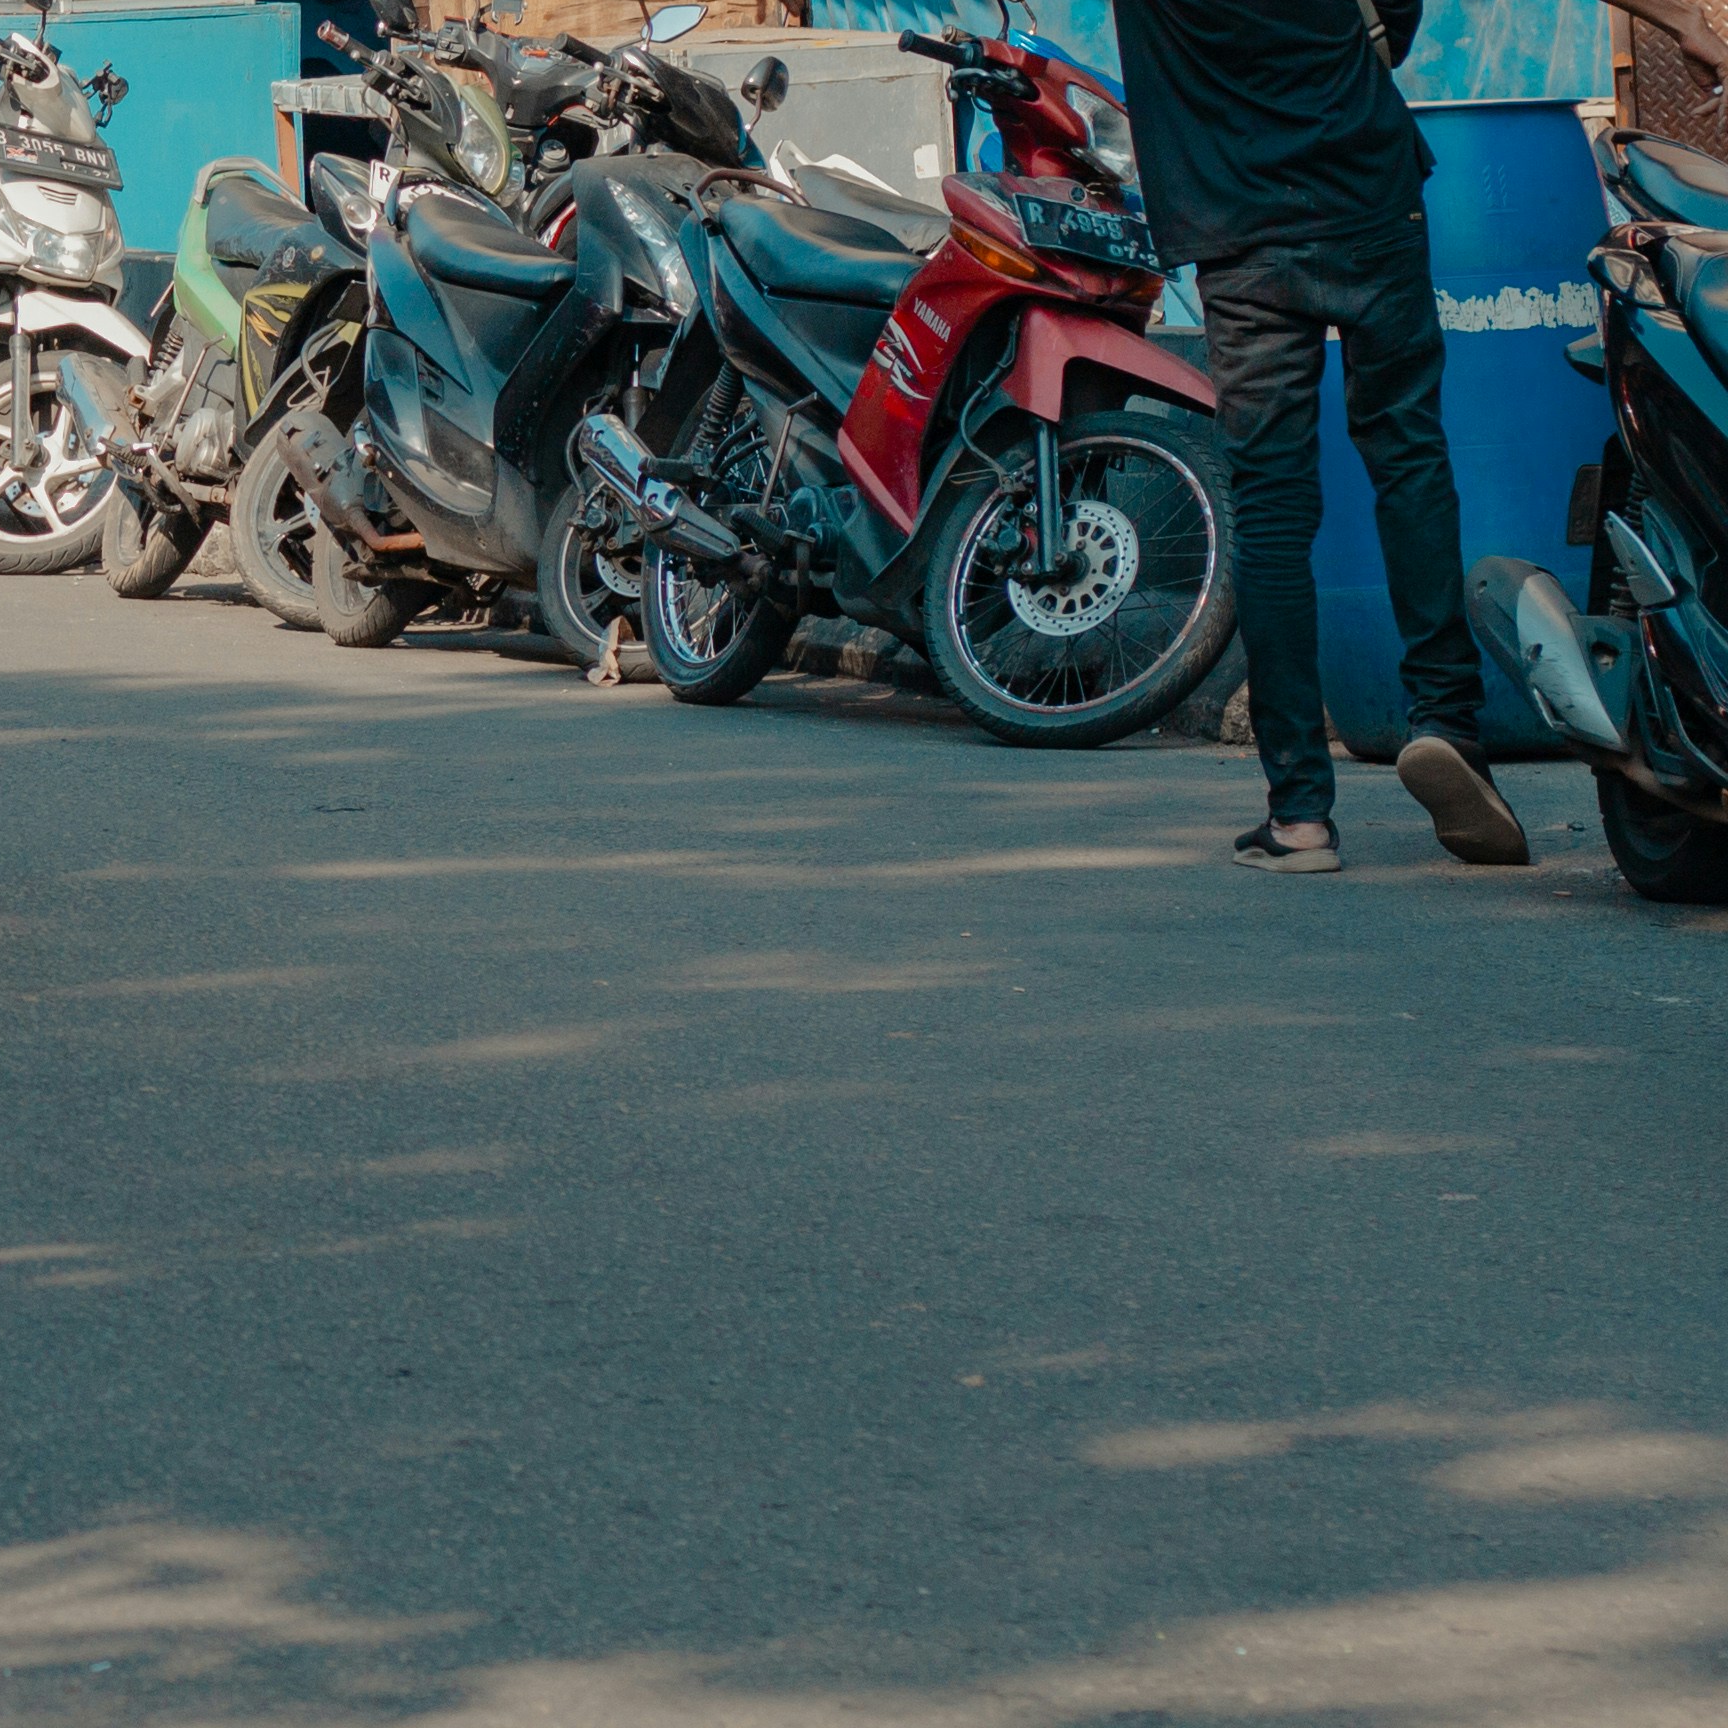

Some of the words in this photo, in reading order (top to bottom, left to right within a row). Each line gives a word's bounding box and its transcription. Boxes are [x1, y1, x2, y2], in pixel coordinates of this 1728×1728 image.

[74, 147, 108, 168] BNV
[379, 166, 390, 183] R
[1028, 201, 1045, 224] R
[912, 296, 951, 343] YAMAHA
